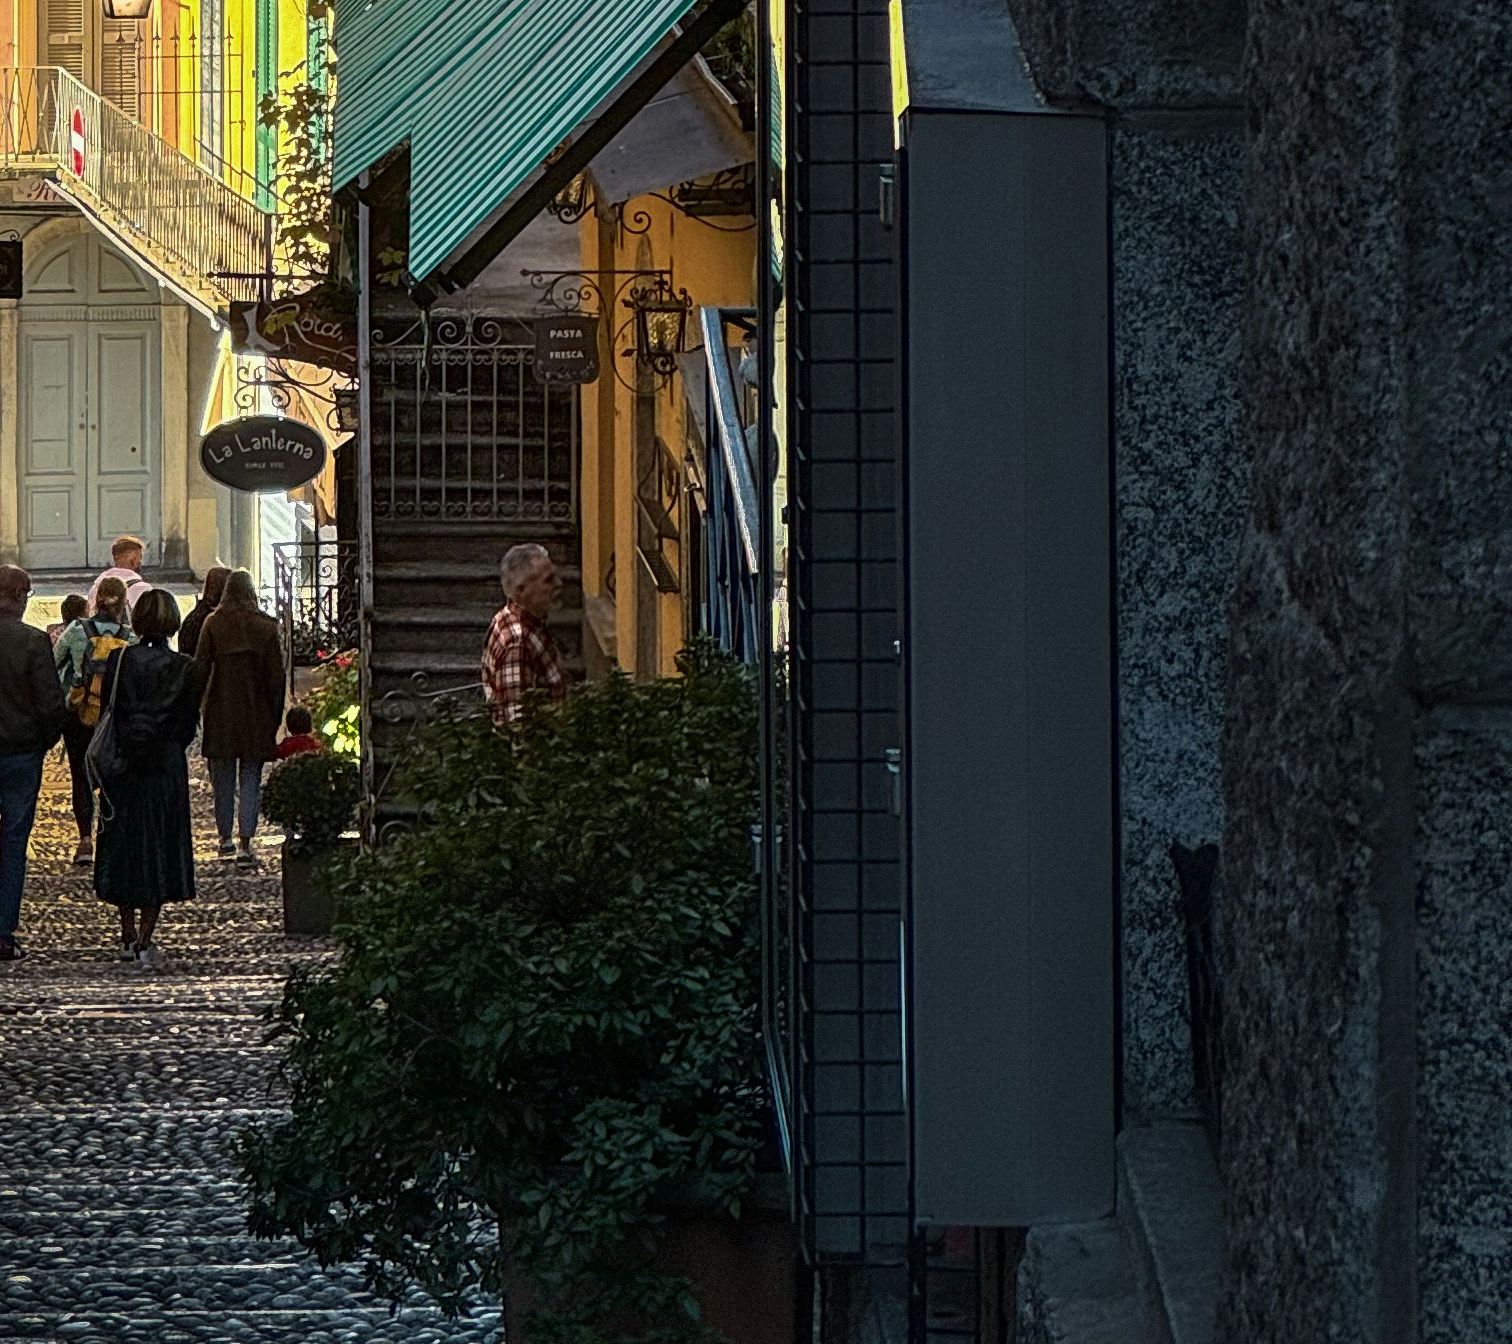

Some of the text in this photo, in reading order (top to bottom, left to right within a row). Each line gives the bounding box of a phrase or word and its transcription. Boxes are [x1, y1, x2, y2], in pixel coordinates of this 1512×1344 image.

[549, 329, 583, 339] PASTA
[549, 350, 584, 359] FRESCA
[208, 427, 314, 464] La Lanterna
